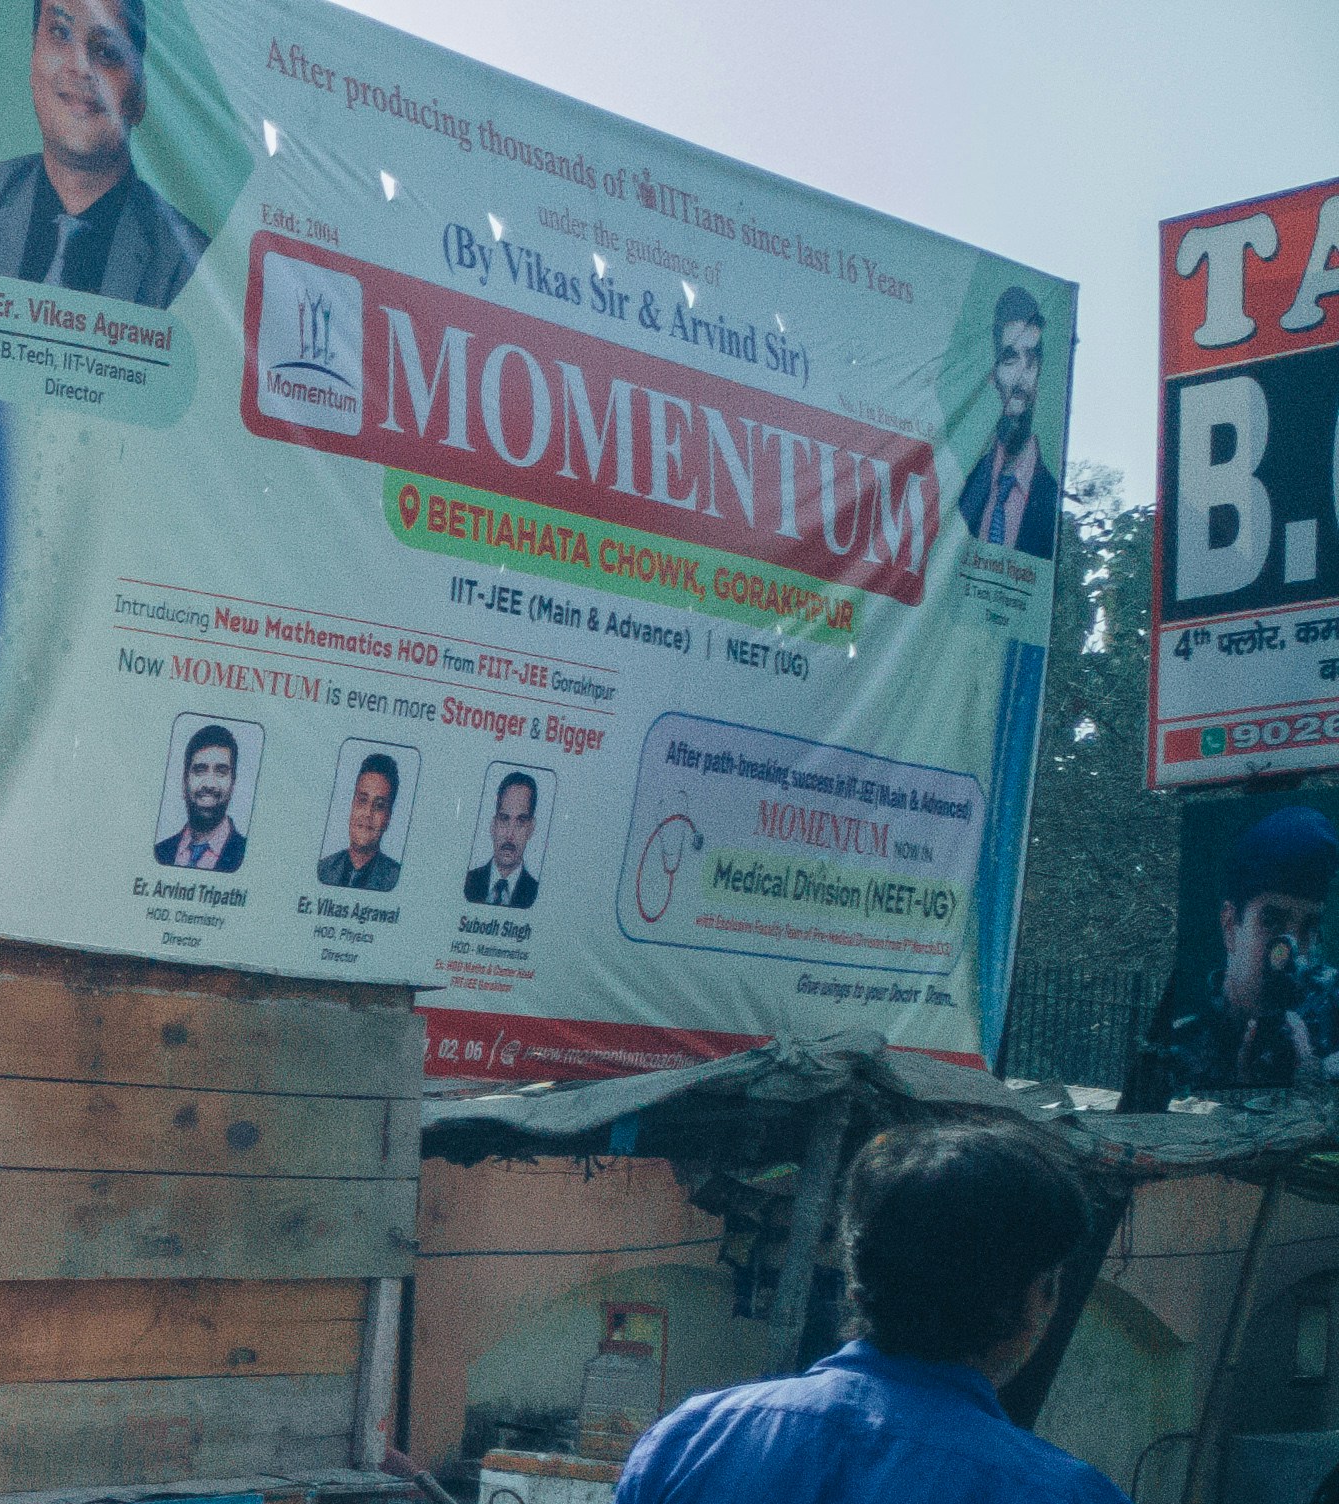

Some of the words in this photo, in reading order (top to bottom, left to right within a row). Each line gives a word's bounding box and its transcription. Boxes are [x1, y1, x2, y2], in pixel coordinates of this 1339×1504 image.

[266, 37, 335, 93] After
[344, 75, 471, 152] producing
[478, 120, 596, 190] thousands
[603, 168, 625, 199] of
[742, 218, 791, 261] since
[797, 239, 831, 275] last
[837, 250, 858, 283] 16
[864, 257, 914, 304] Years
[539, 205, 587, 240] under
[593, 220, 620, 251] the
[625, 236, 699, 279] guidance
[704, 261, 721, 287] of
[28, 297, 87, 333] Vikas
[93, 311, 172, 351] Agrawal
[443, 222, 493, 286] (By
[500, 239, 581, 306] Vikas
[589, 272, 630, 321] Sir
[638, 290, 662, 332] &
[669, 300, 757, 364] Arvind
[764, 332, 810, 389] Sir)
[0, 341, 58, 371] B.Tech,
[63, 351, 147, 386] IIT-Varanasi
[44, 378, 105, 405] Director
[266, 371, 357, 414] Momentum
[379, 306, 928, 575] MOMENTUM
[428, 493, 592, 568] BETIAHATA
[599, 539, 708, 598] CHOWK,
[714, 567, 854, 634] GORAKHPUR
[450, 576, 522, 616] IIT-JEE
[528, 593, 581, 628] (Main
[587, 607, 599, 632] &
[605, 612, 691, 655] Advance)
[726, 638, 770, 669] NEET
[773, 648, 810, 681] (UG)
[1174, 627, 1211, 661] 4th
[214, 606, 259, 636] New
[265, 614, 392, 660] Mathematics
[397, 638, 438, 667] HOD
[443, 648, 474, 675] from
[477, 654, 548, 688] FIIT-JEE
[552, 671, 615, 704] Gorakhpur
[118, 648, 165, 677] Now
[170, 655, 321, 703] MOMENTUM
[326, 680, 340, 706] is
[347, 688, 387, 715] even
[392, 697, 437, 722] more
[441, 696, 528, 742] Stronger
[530, 716, 541, 740] &
[545, 715, 605, 755] Bigger
[666, 740, 701, 770] After
[703, 751, 789, 790] path-breaking
[791, 770, 834, 795] success
[910, 789, 919, 811] &
[753, 799, 890, 858] MOMENTUM
[133, 877, 149, 898] Er.
[153, 879, 195, 903] Arvind
[198, 884, 248, 908] Tripathi
[297, 896, 313, 914] Er.
[317, 898, 349, 919] Vikas
[351, 902, 401, 925] Agrawal
[713, 859, 789, 899] Medical
[792, 870, 861, 909] Division
[864, 877, 958, 927] (NEET-UG)
[161, 931, 202, 949] Director
[174, 910, 225, 930] Chemistry
[340, 927, 374, 945] Physics
[459, 915, 499, 937] Subodh
[501, 919, 532, 943] Singh
[321, 948, 359, 964] Director
[450, 940, 471, 955] HOD
[476, 943, 529, 962] Mathematics
[438, 1038, 459, 1063] 02,
[465, 1040, 484, 1062] 06
